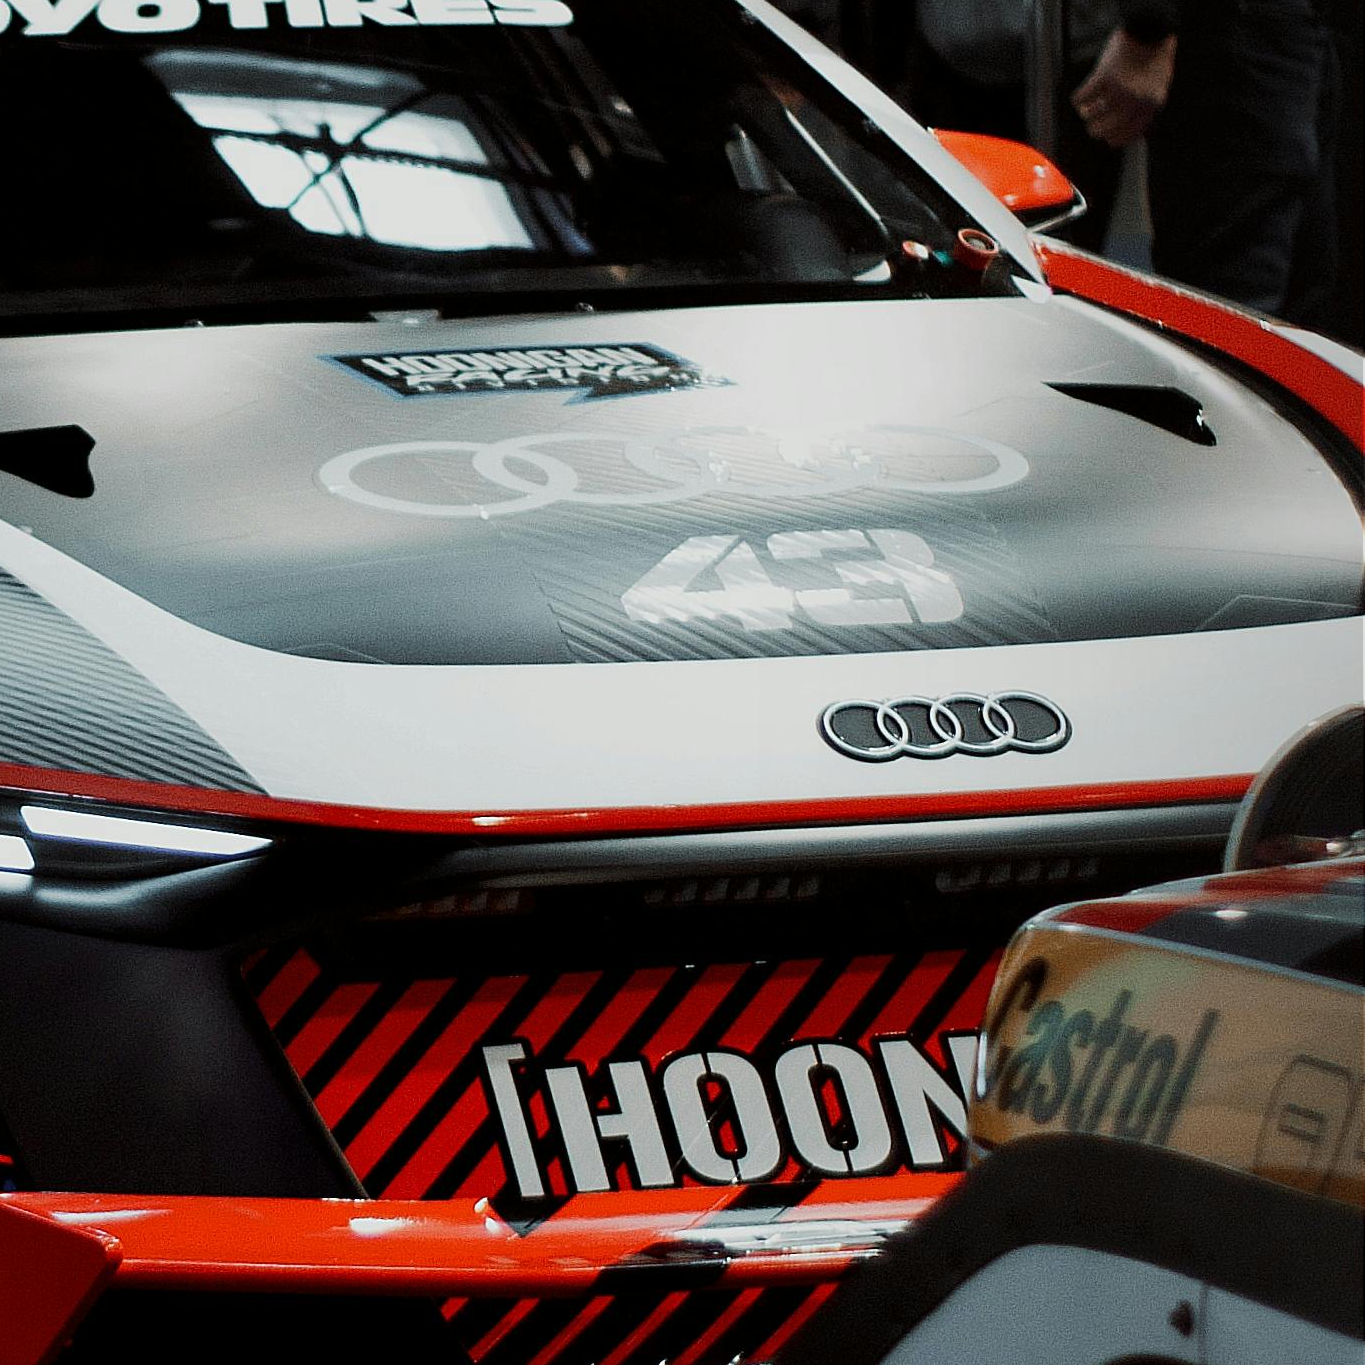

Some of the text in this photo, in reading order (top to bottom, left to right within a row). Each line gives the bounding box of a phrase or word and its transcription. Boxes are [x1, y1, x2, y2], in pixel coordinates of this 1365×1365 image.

[362, 347, 660, 376] HOONIGAN
[620, 528, 964, 632] 43
[982, 959, 1220, 1146] Castrol
